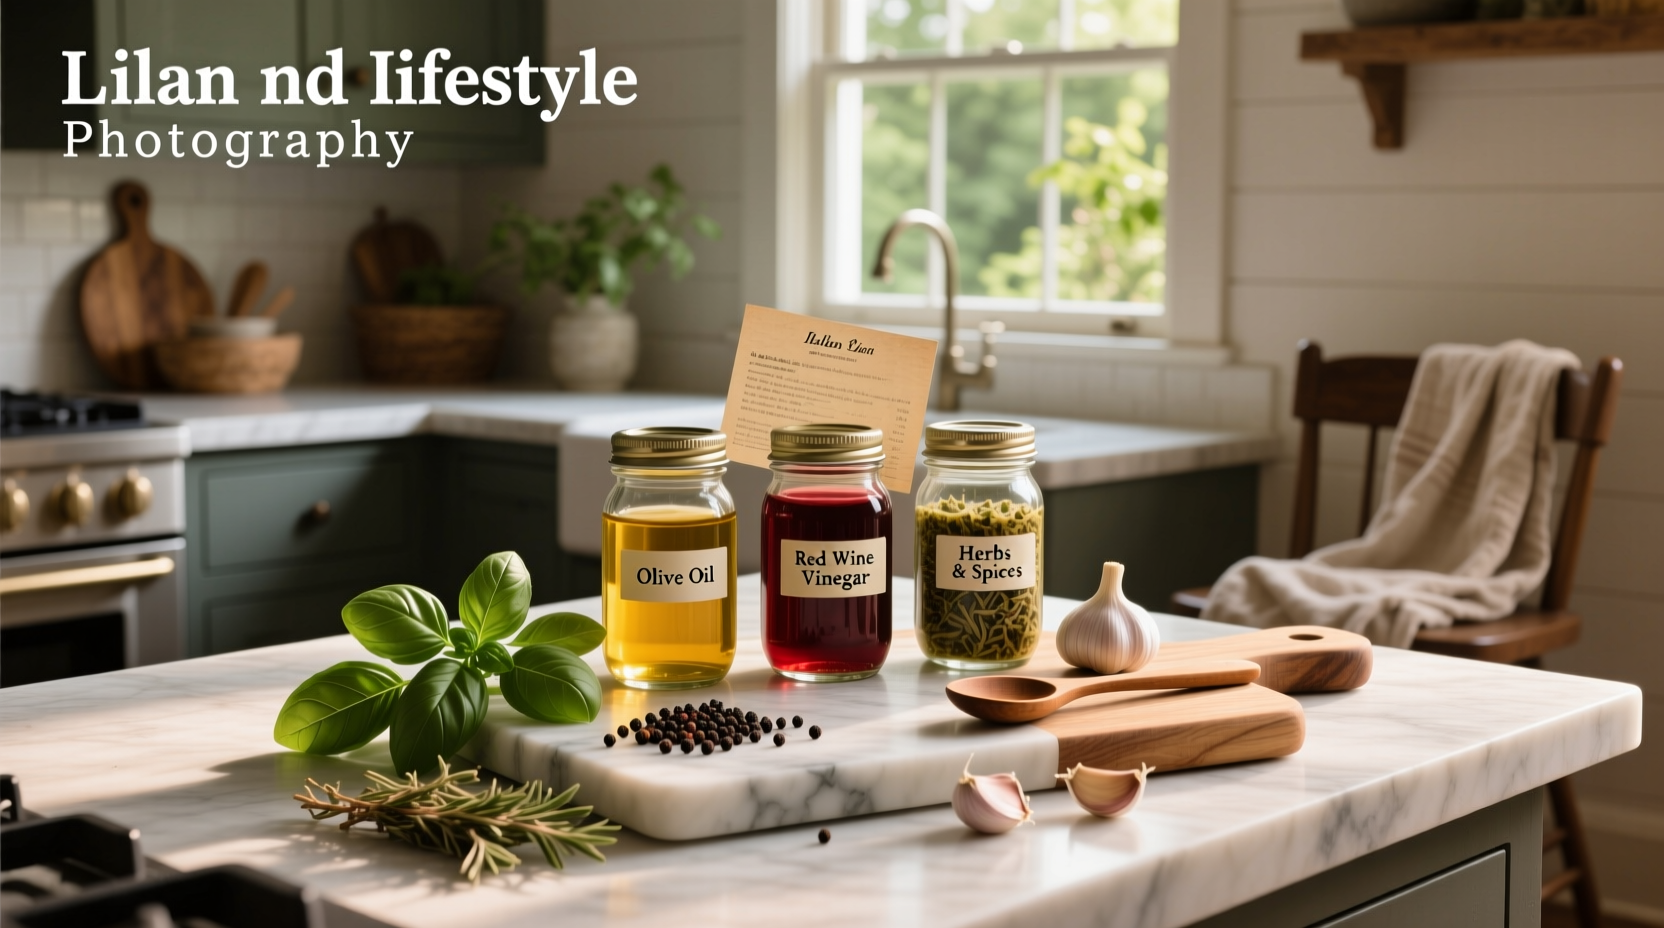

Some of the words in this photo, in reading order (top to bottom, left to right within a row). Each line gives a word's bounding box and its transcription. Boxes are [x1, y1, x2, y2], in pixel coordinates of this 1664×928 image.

[795, 550, 827, 567] Red
[832, 549, 875, 566] Wine
[959, 544, 1012, 561] Herbs
[636, 567, 684, 586] Olive
[688, 565, 715, 584] Oil
[802, 569, 870, 590] Vinegar
[951, 563, 966, 579] &
[971, 563, 1022, 582] Spices
